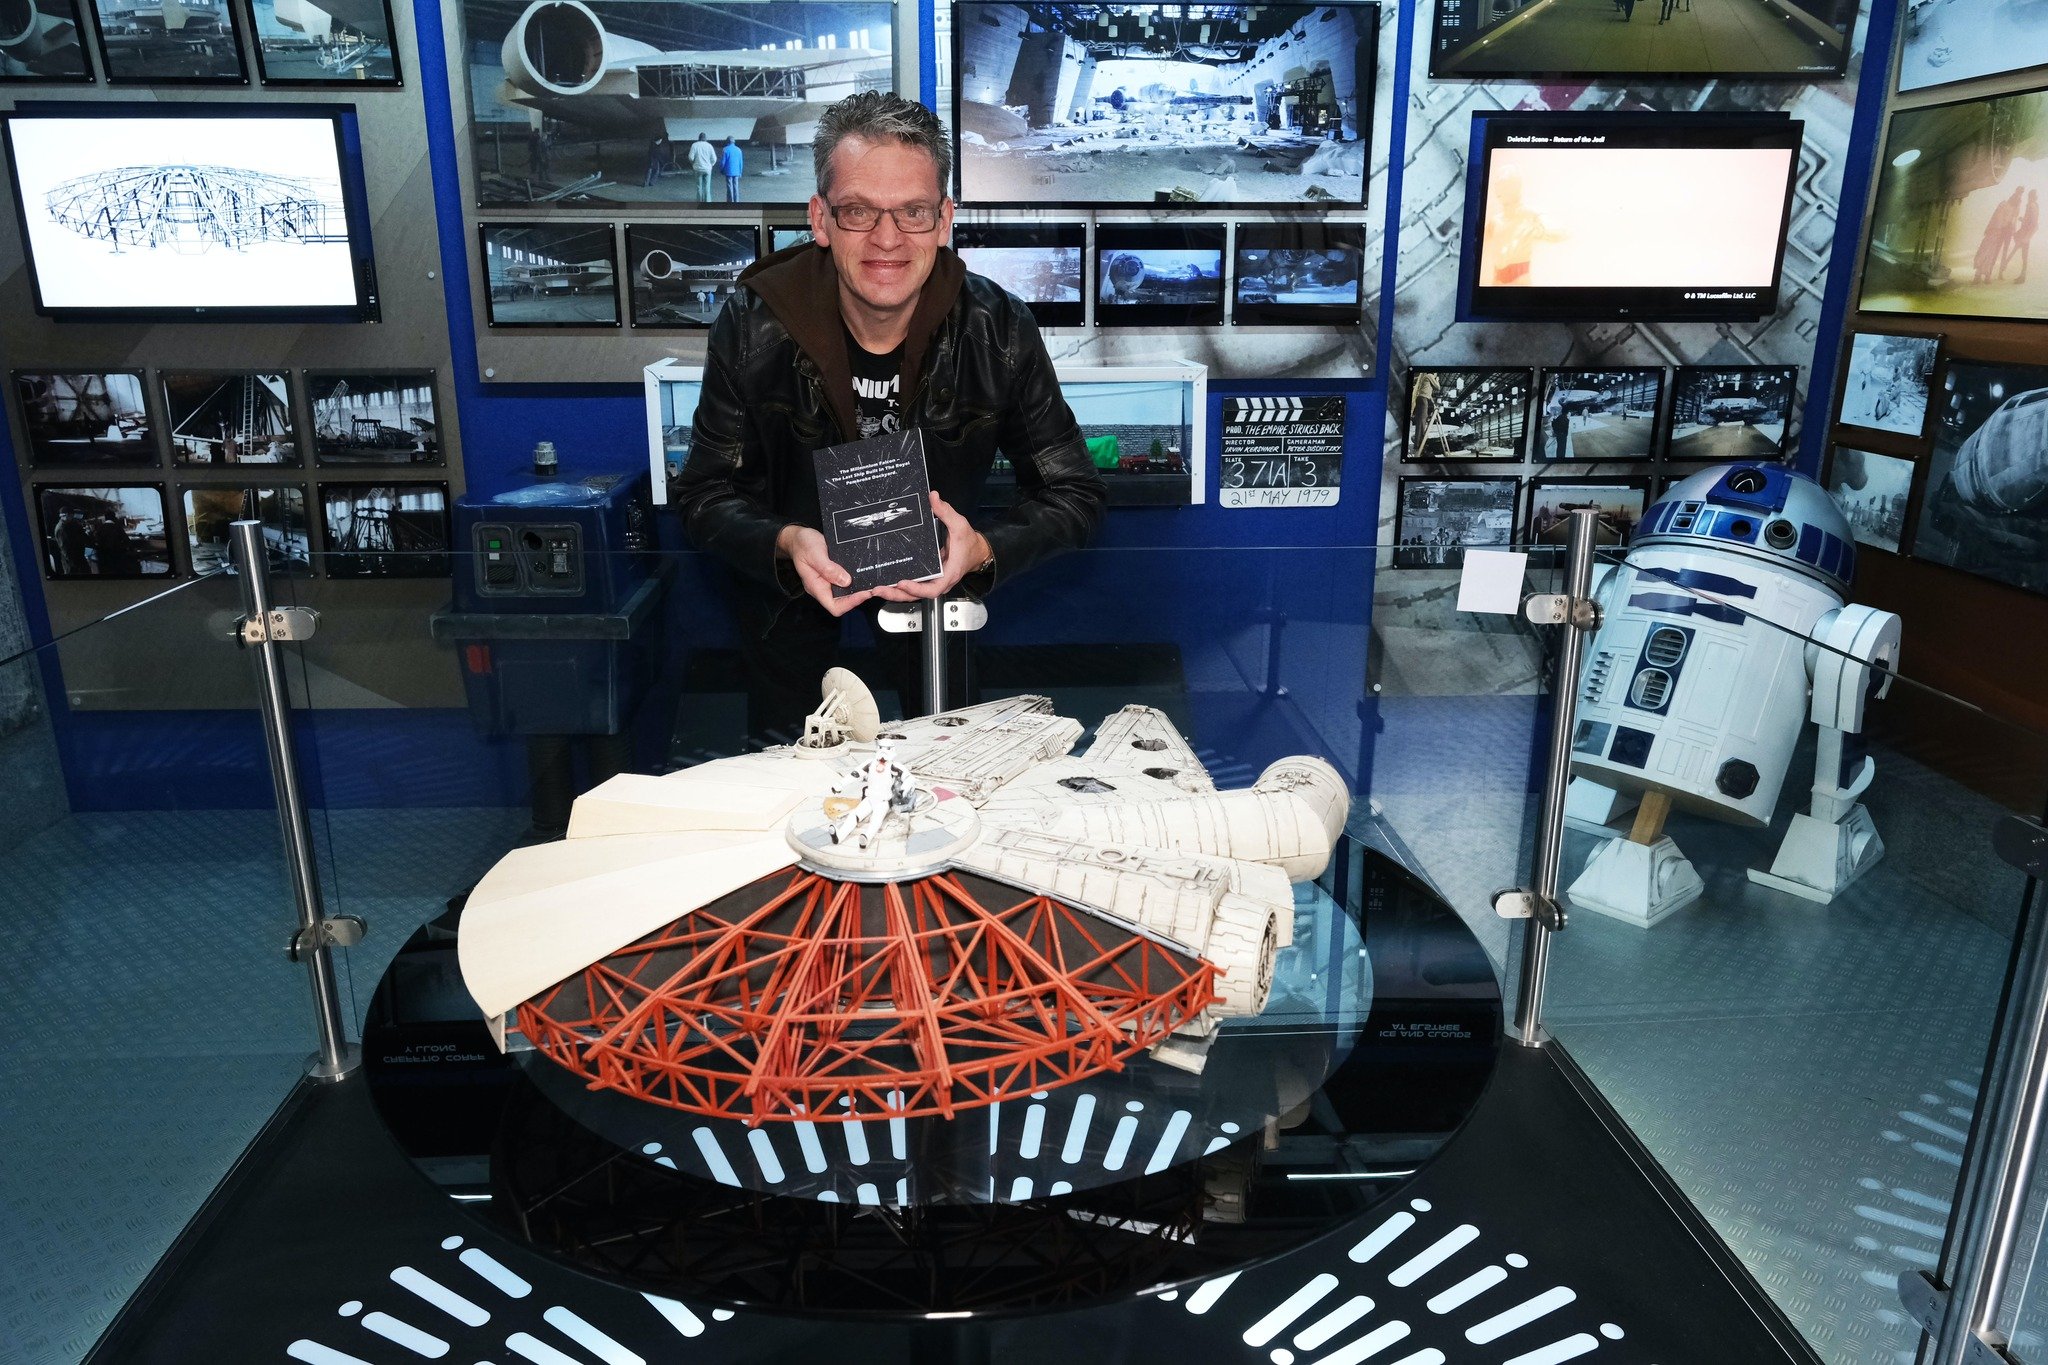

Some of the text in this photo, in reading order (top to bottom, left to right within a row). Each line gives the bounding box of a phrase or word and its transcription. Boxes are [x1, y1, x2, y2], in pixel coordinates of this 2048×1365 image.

[1226, 423, 1341, 435] PROD. THE EMPIRE STRIKES BACK
[850, 463, 878, 472] Millennium
[1301, 462, 1317, 486] 3
[846, 476, 871, 485] Pembroke
[1261, 489, 1291, 505] MAY
[1297, 489, 1330, 503] 1979
[856, 564, 874, 573] Gareth
